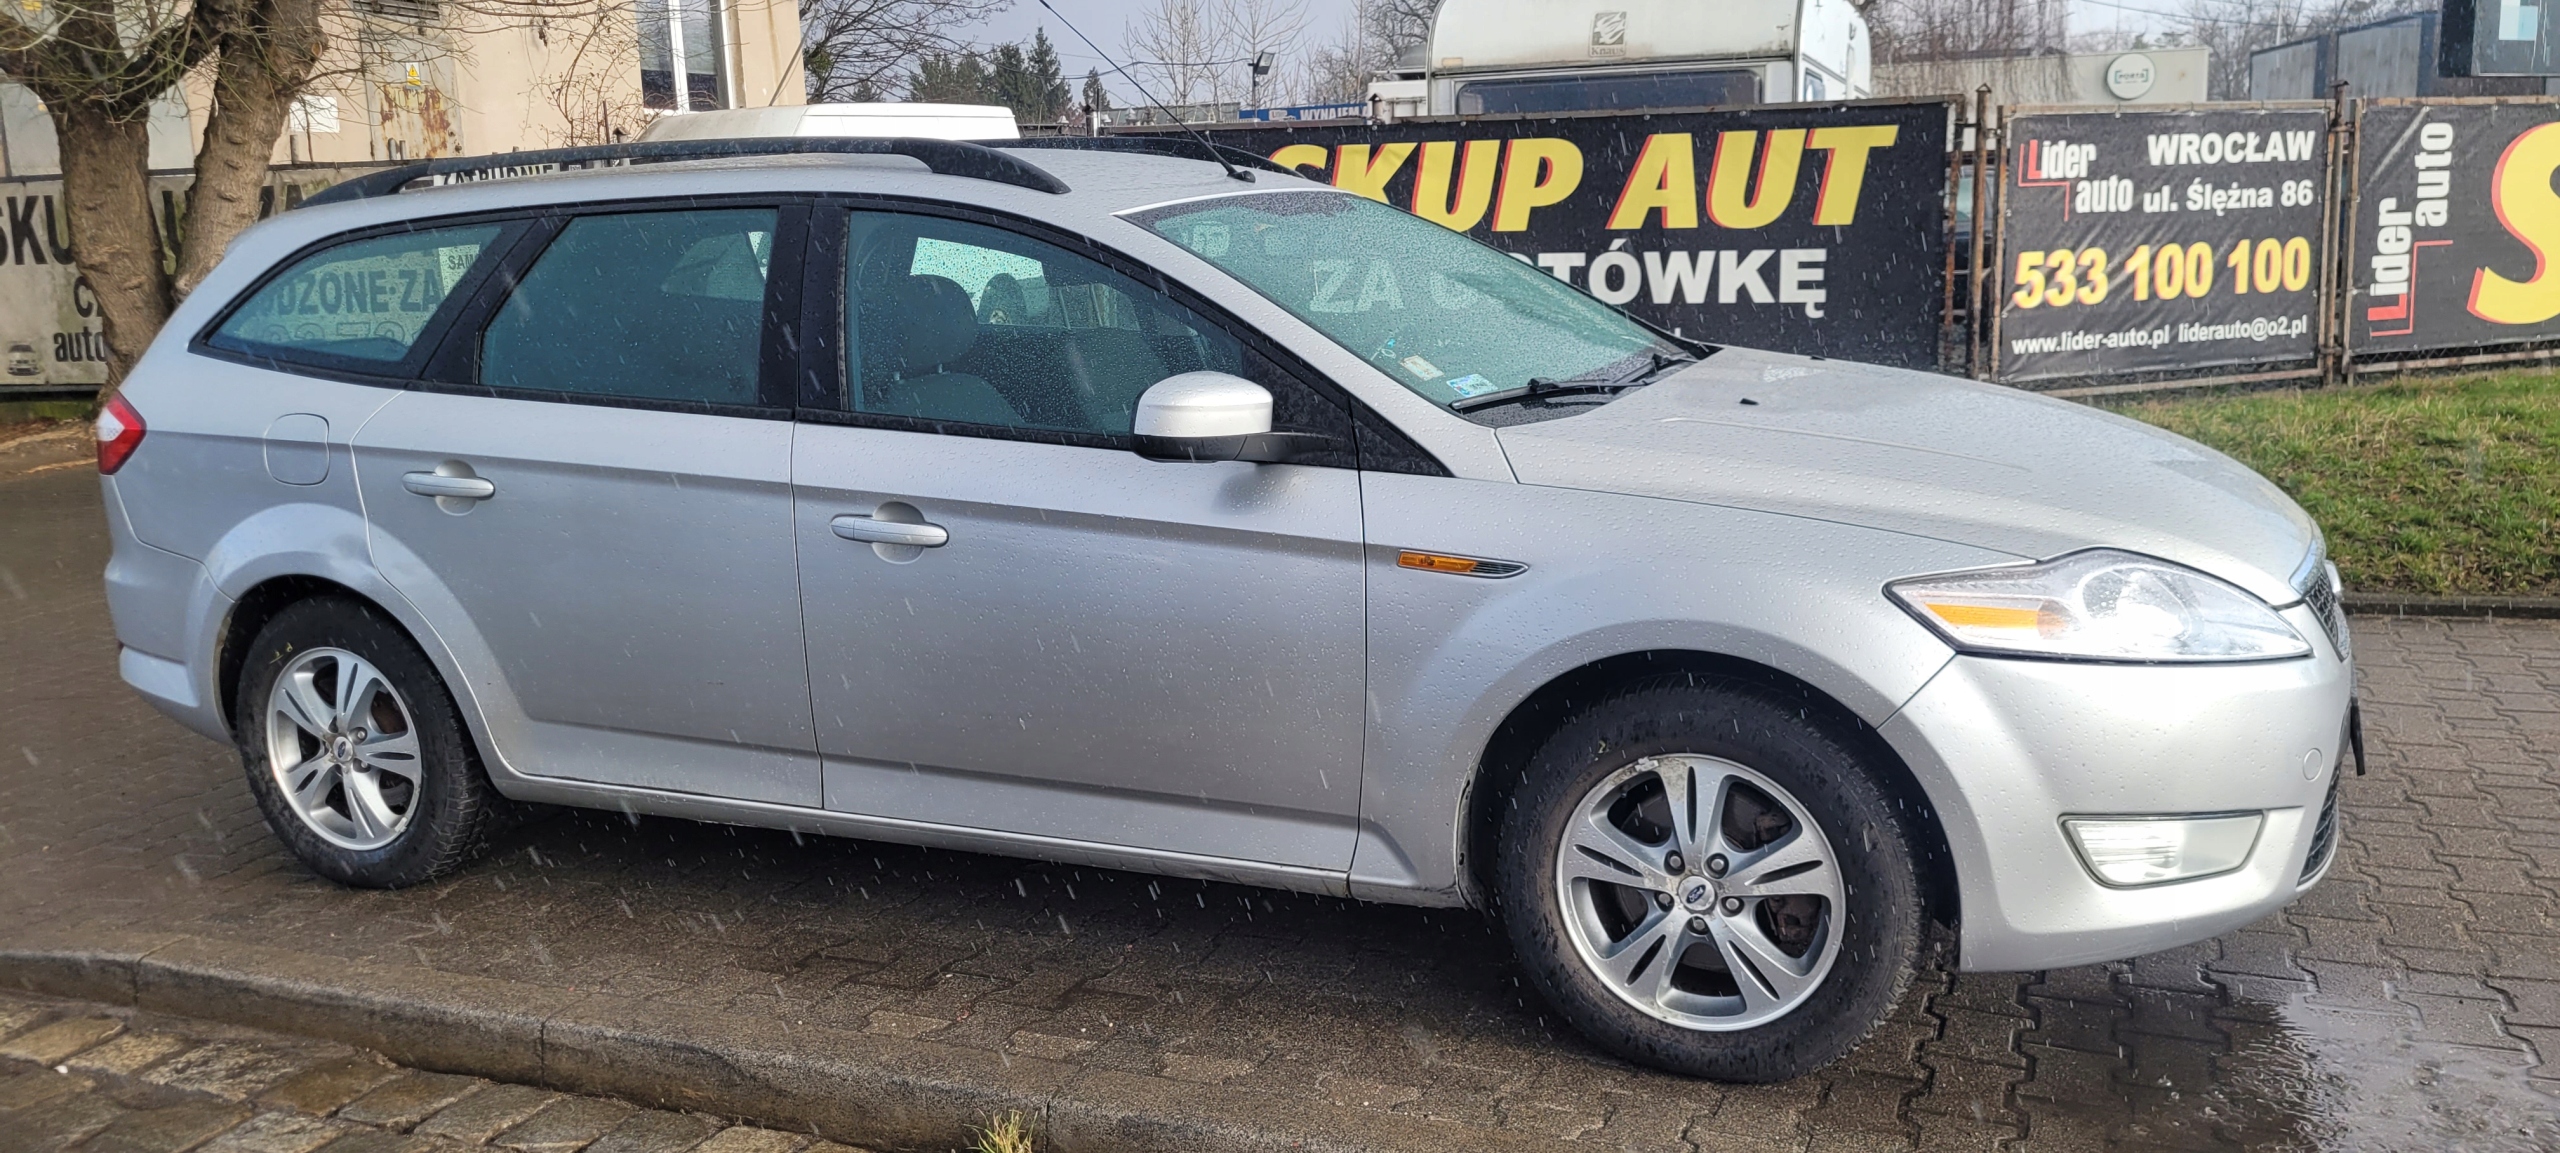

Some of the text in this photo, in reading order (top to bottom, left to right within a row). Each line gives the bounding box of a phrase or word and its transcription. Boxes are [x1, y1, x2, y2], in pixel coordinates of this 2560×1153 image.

[2027, 139, 2097, 179] Lider
[2147, 130, 2316, 166] WROCŁAW
[1605, 124, 1899, 230] AUT
[2075, 174, 2134, 213] auto
[2414, 122, 2454, 227] auto
[2142, 177, 2314, 216] ul. Ślężna 86
[2012, 236, 2311, 309] 533 100 100
[2367, 197, 2413, 321] Lider
[2011, 314, 2308, 355] www.lider-auto.pl liderauto@o2.pl
